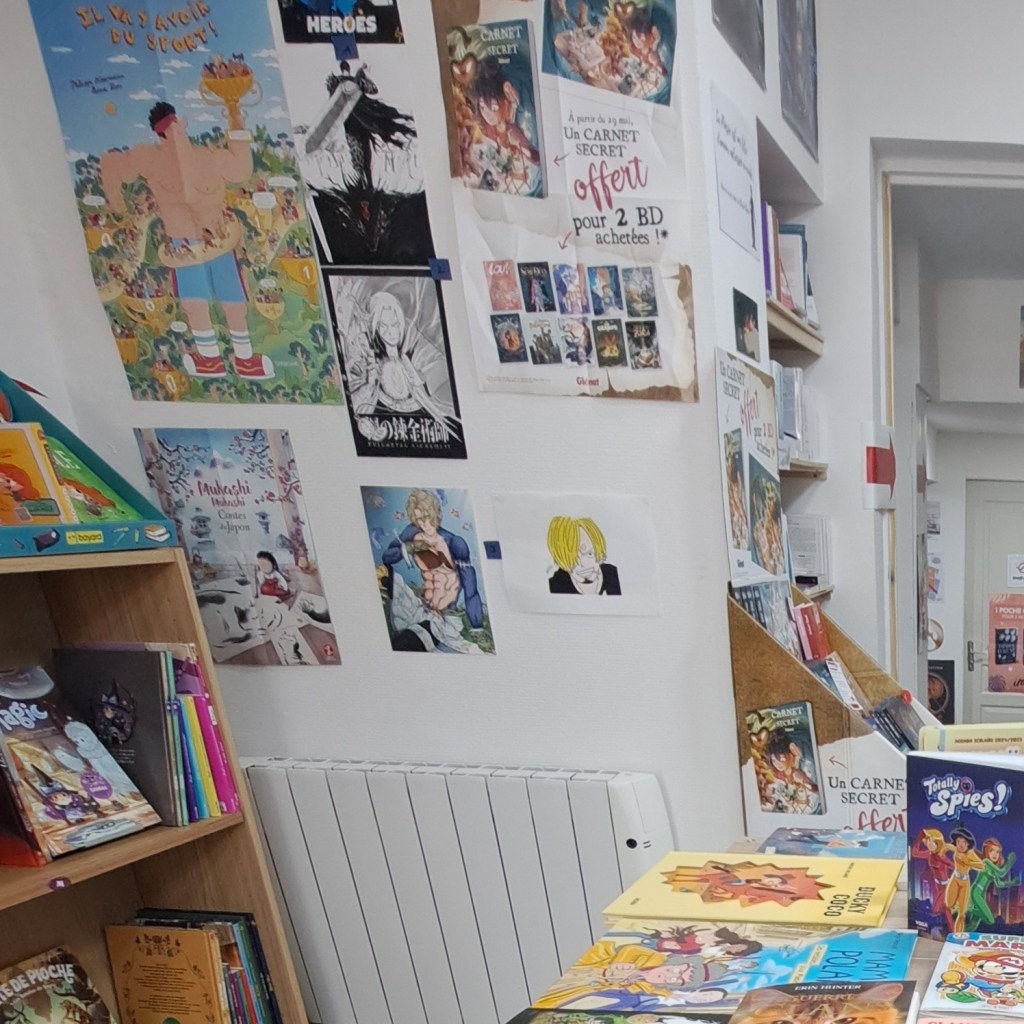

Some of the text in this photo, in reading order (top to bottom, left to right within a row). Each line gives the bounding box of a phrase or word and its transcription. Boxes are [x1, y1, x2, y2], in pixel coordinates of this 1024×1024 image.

[306, 15, 378, 34] HEROES
[481, 25, 522, 41] CARNET
[487, 44, 519, 56] SECRET
[563, 127, 640, 143] Un CARNET
[576, 143, 627, 158] SECRET
[574, 156, 648, 213] offert
[572, 206, 664, 236] pour 2 BD
[595, 227, 650, 245] achetées
[197, 479, 251, 496] Mukashi
[0, 701, 48, 730] agic
[771, 707, 804, 719] CARNET
[828, 776, 907, 791] Un CARNE
[923, 776, 960, 796] Totally
[840, 792, 902, 807] SECRET
[929, 783, 1007, 816] Spies!
[824, 894, 850, 917] COCO
[816, 950, 863, 981] POLA
[9, 963, 75, 993] DE PIOCHE
[820, 983, 862, 991] HUNTER
